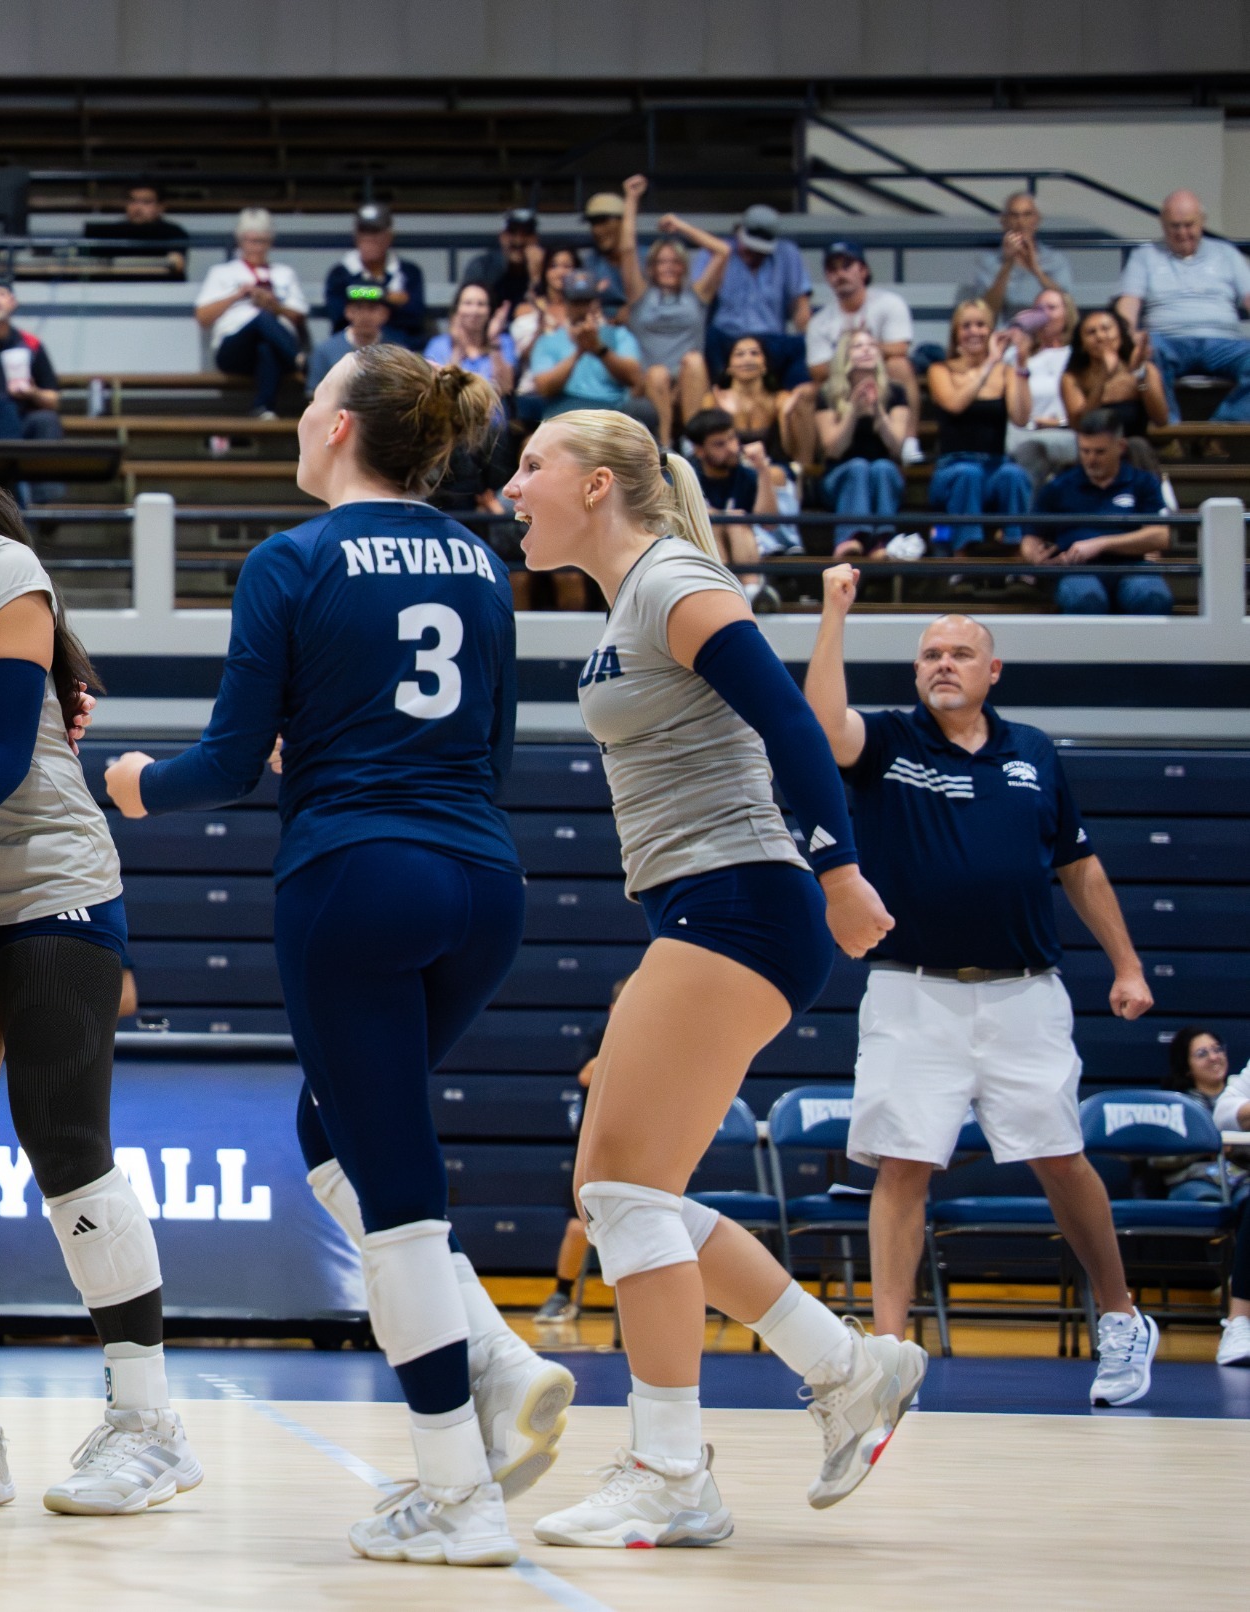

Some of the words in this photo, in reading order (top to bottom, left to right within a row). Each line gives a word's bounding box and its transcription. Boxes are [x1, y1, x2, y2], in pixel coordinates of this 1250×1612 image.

[340, 536, 497, 583] NEVADA
[395, 602, 464, 720] 3
[1103, 1102, 1188, 1138] NEVADA
